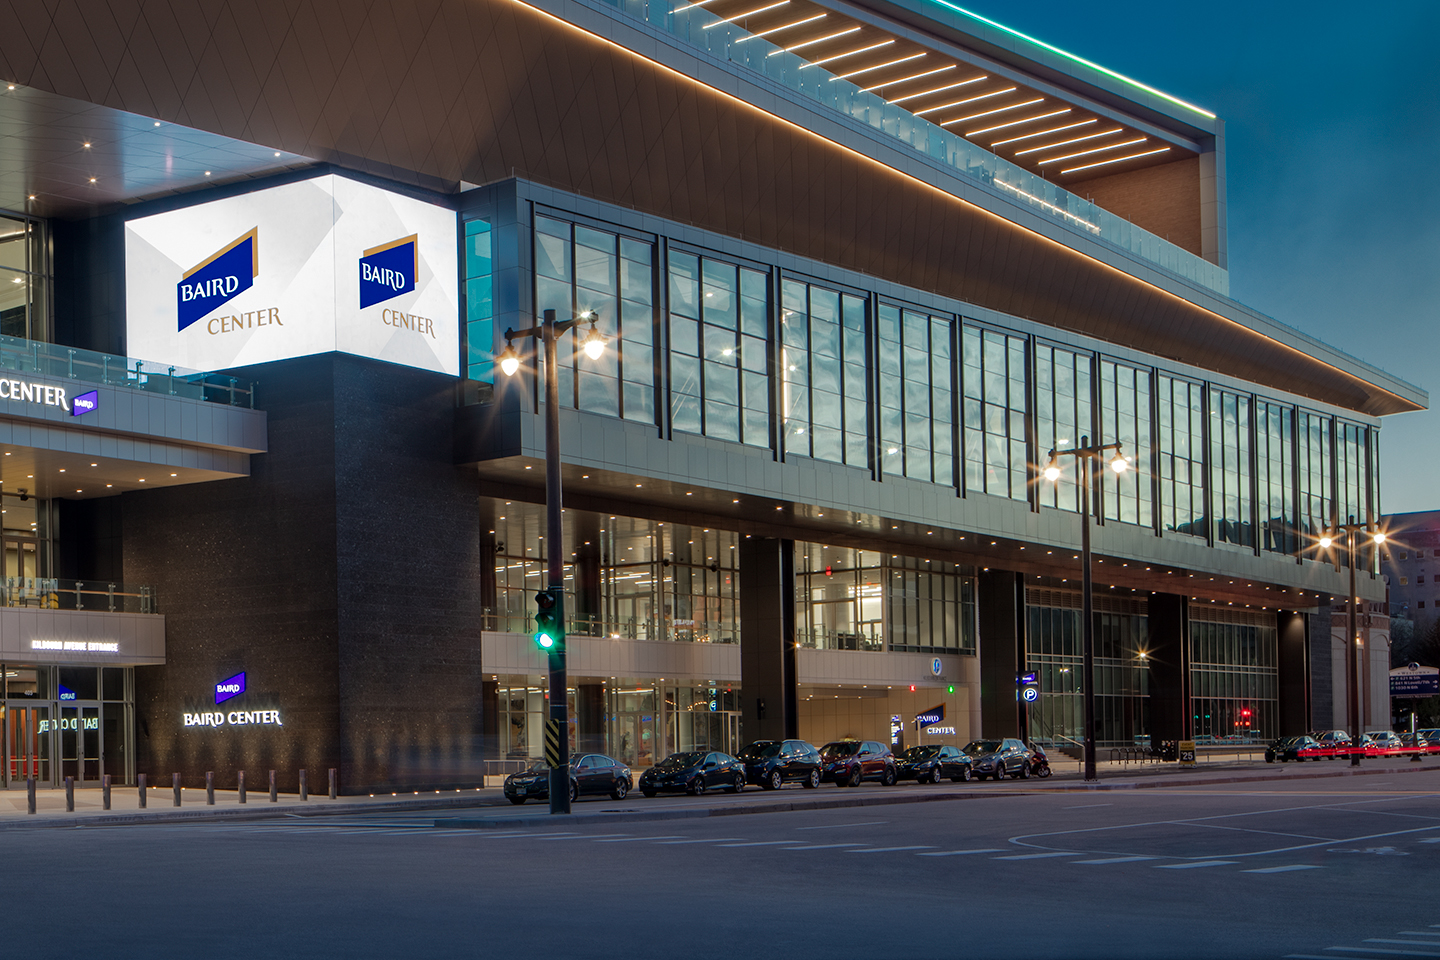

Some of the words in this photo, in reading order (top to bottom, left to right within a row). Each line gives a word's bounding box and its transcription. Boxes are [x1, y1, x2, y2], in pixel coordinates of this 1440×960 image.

[362, 262, 406, 292] BAIRD
[181, 275, 240, 303] BAIRD
[207, 307, 284, 335] CENTER
[382, 308, 436, 340] CENTER
[74, 398, 94, 410] BAIRD
[217, 684, 241, 694] BAIRD
[183, 712, 225, 728] BAIRD
[227, 709, 283, 726] CENTER
[927, 726, 956, 735] CENTER
